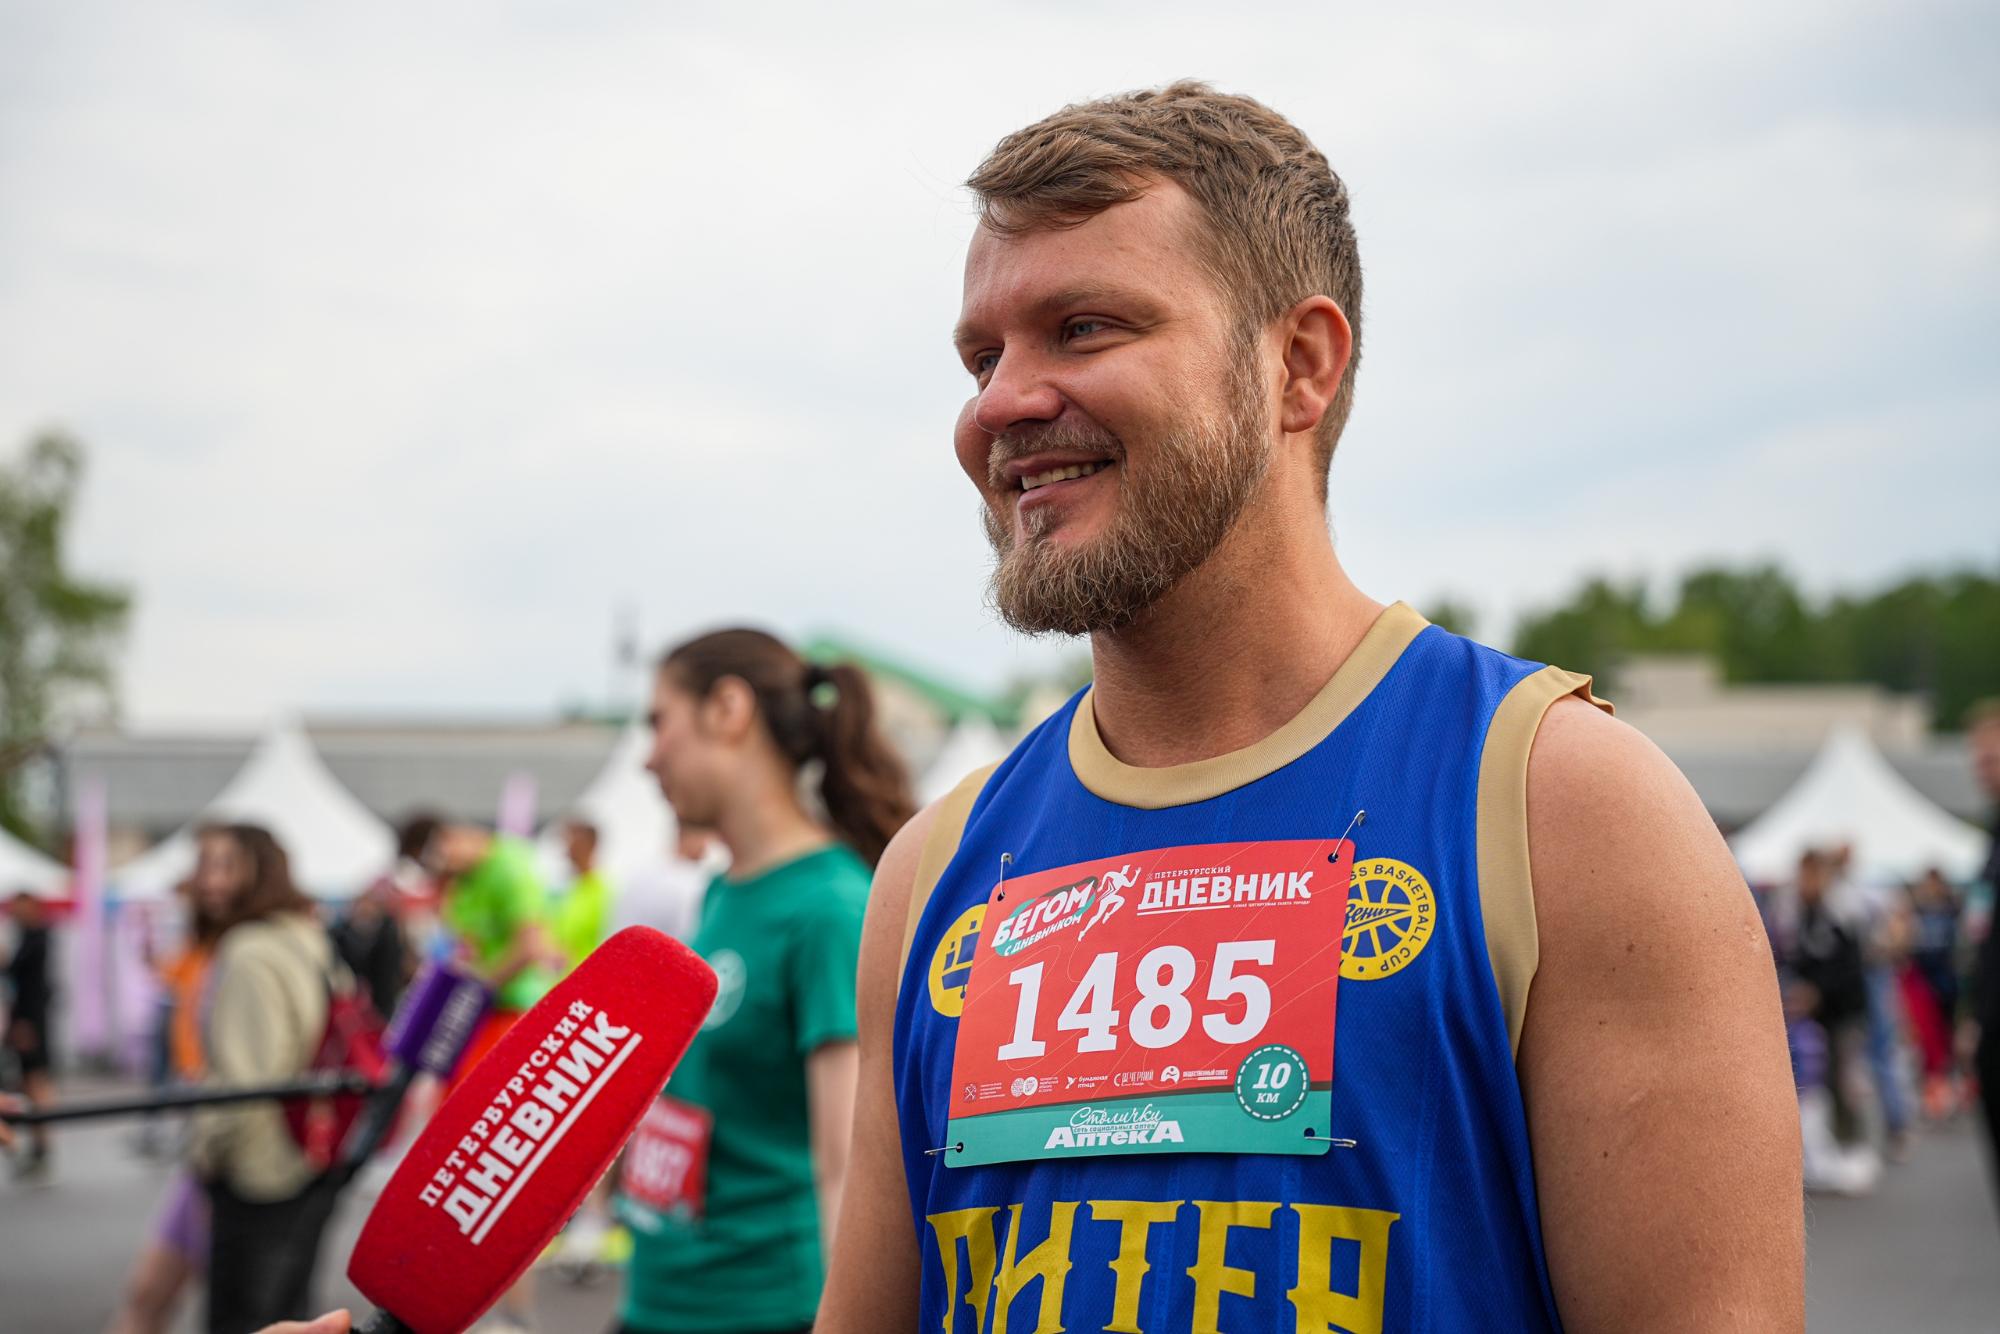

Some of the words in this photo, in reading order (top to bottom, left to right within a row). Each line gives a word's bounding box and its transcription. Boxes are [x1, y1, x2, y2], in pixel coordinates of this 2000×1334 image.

[1137, 871, 1313, 910] ДНЕВНИК
[1154, 866, 1231, 879] ПЕТЕРБУРГСКИЙ
[991, 880, 1095, 947] БЕГОМ
[1374, 864, 1429, 943] BASKETBALL
[1010, 914, 1082, 955] ДНЕВНИКОМ
[1380, 947, 1411, 972] CUP
[997, 939, 1277, 1062] 1485
[1252, 1062, 1291, 1089] 10
[418, 999, 594, 1207] ПЕТЕРБУРГСКИЙ
[1069, 1104, 1163, 1127] Столички
[1256, 1092, 1280, 1103] КМ
[442, 1010, 631, 1235] ДНЕВНИК
